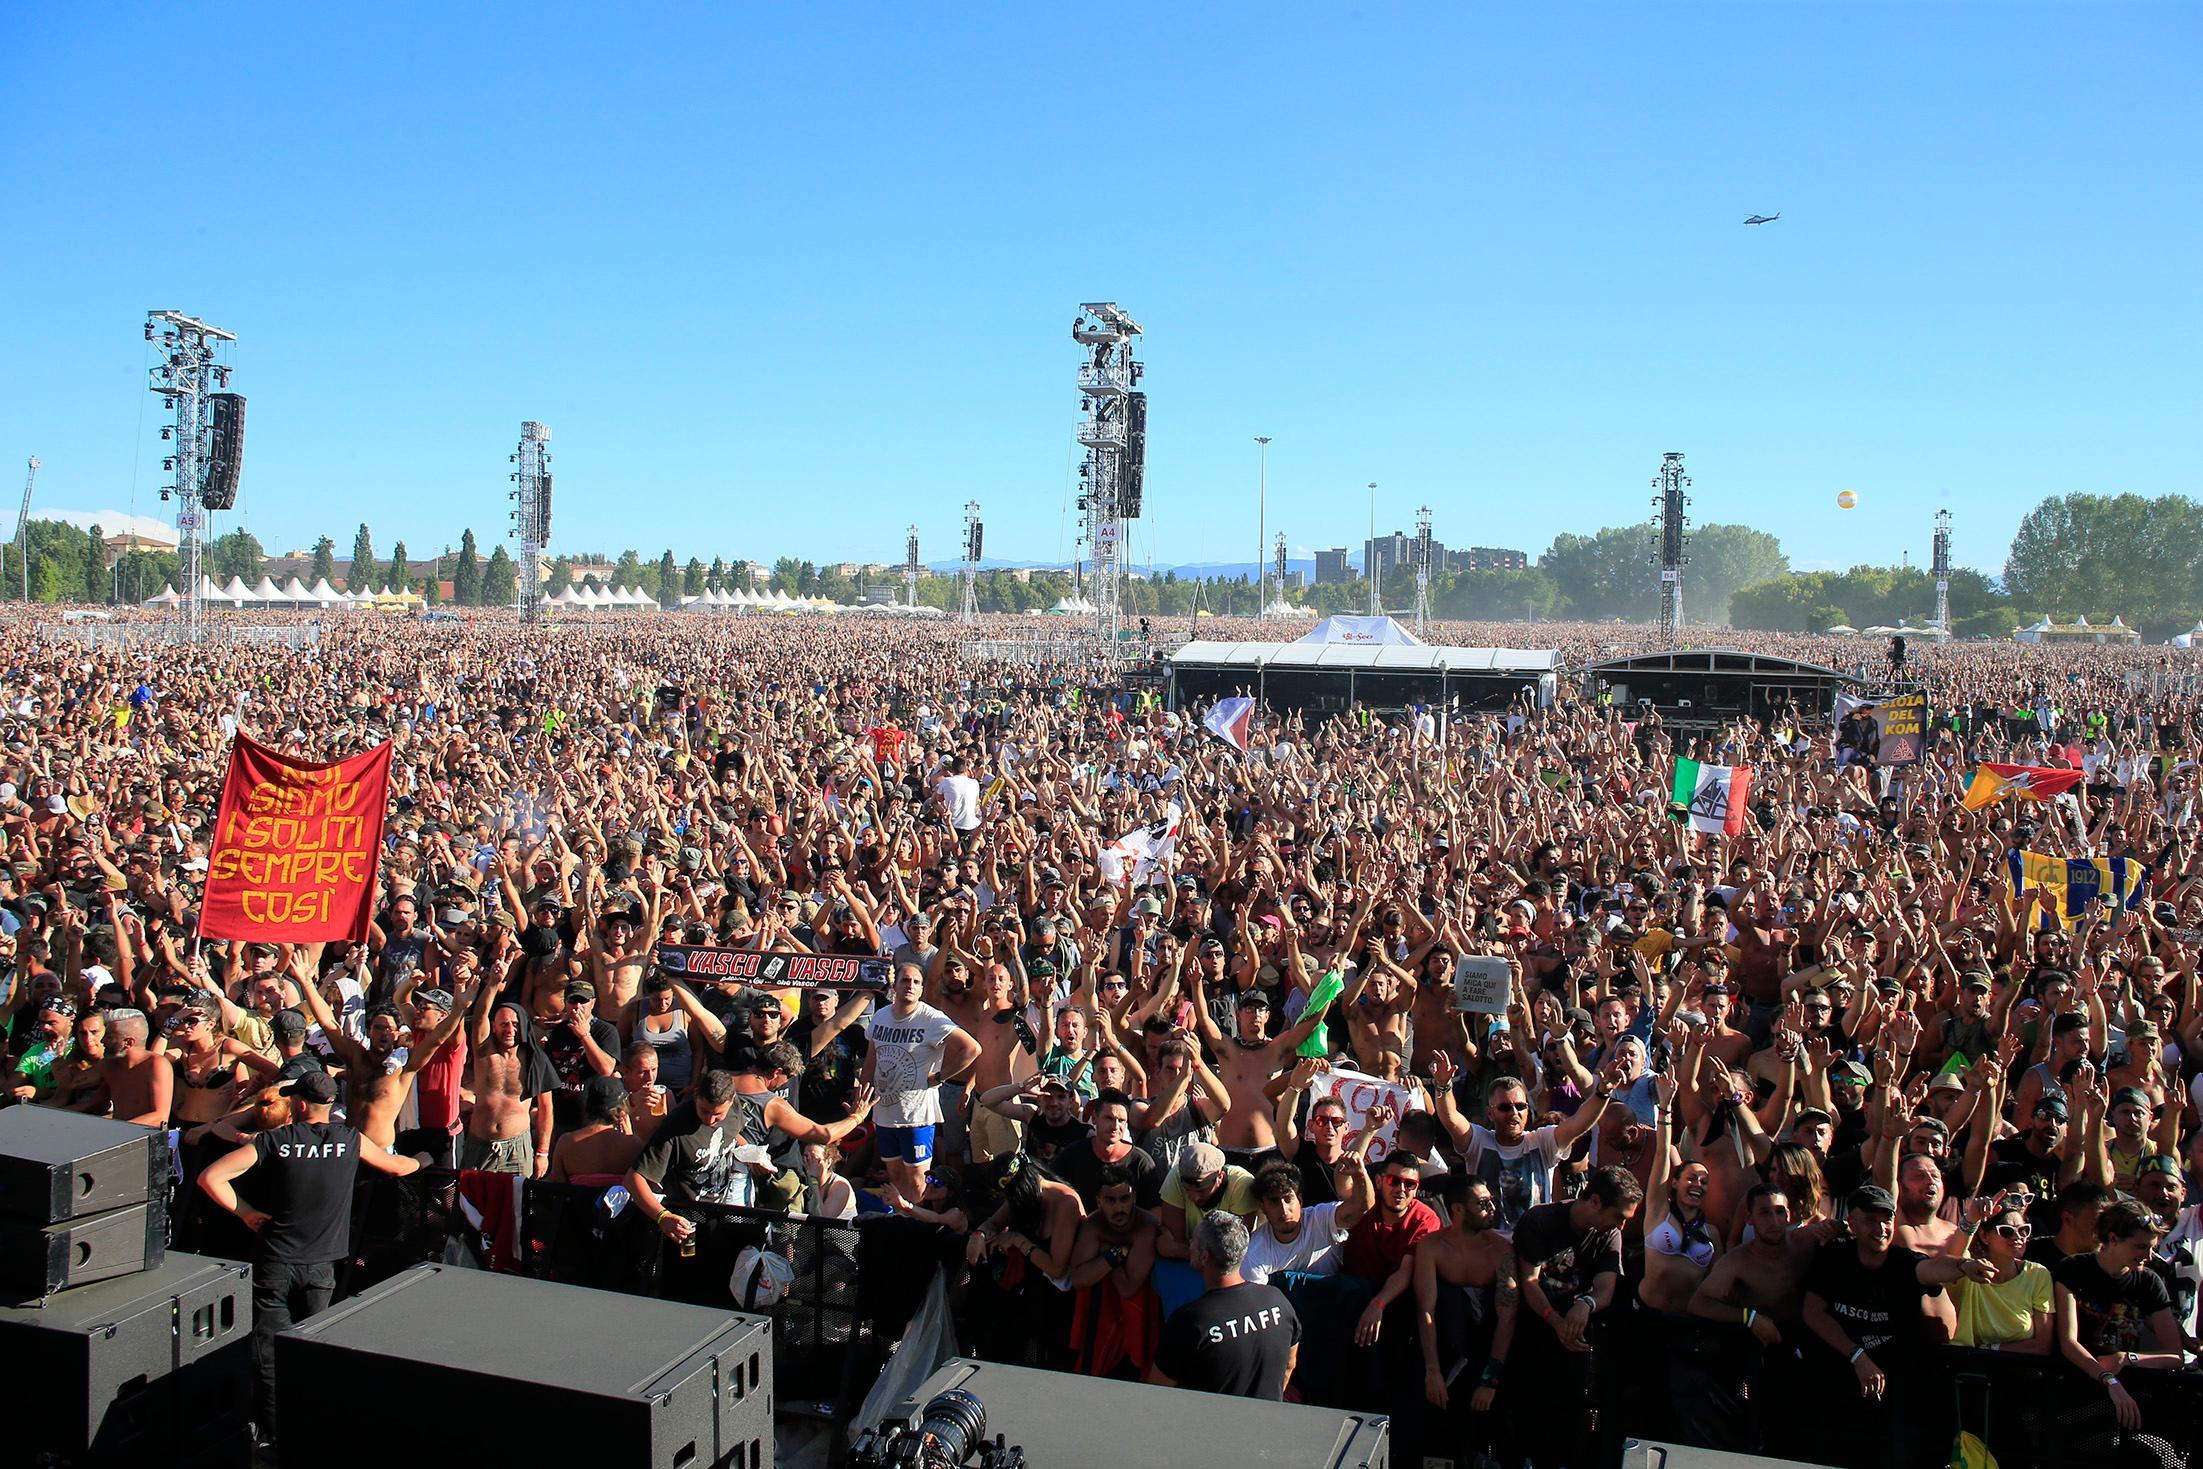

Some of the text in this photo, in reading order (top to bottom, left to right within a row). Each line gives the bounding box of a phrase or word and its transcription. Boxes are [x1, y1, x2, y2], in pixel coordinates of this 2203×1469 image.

[1101, 527, 1115, 537] A4
[1888, 709, 1916, 721] DEL
[1884, 723, 1920, 736] KOM
[223, 811, 364, 851] I SOLITI
[211, 848, 367, 885] SEMPRE
[2070, 869, 2096, 885] 1912
[687, 951, 859, 982] VASCO VASCO
[1464, 970, 1488, 980] SIAMO
[1463, 979, 1497, 989] MICA QUI
[1469, 986, 1487, 995] FARE
[1462, 994, 1494, 1004] SALOTTO.
[872, 1024, 925, 1044] RAMONES
[278, 1142, 347, 1159] STAFF
[914, 1144, 927, 1158] 10
[1834, 1301, 1869, 1321] VASCO
[1208, 1306, 1281, 1343] STAFF
